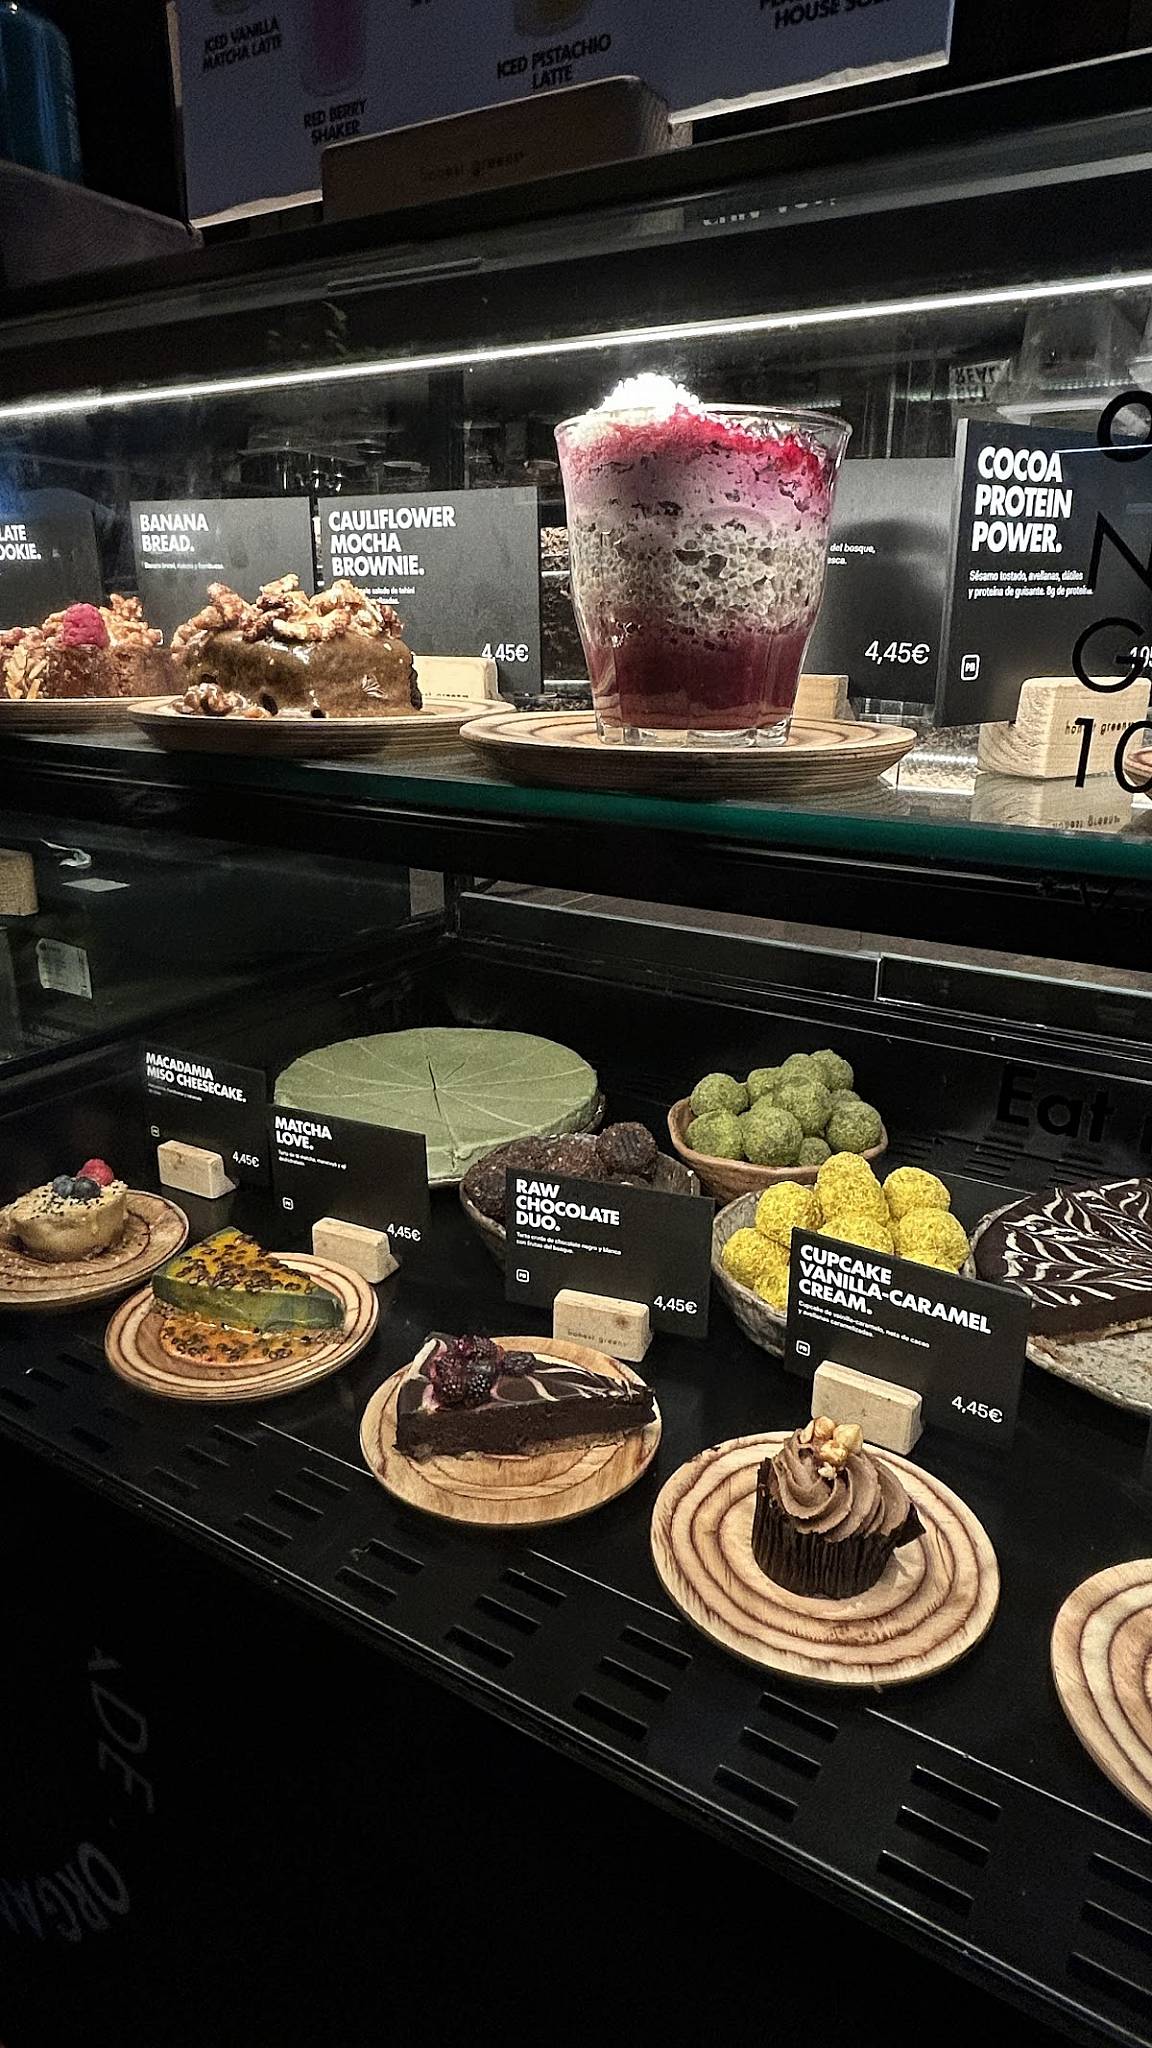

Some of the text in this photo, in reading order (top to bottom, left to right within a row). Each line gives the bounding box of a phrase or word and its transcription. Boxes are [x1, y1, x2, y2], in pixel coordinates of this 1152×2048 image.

[204, 16, 280, 54] ICED VANILLA
[202, 34, 283, 73] MATCHA LATTE
[497, 34, 611, 79] ICED PISTACHIO
[531, 65, 574, 90] LATTE
[303, 98, 368, 129] RED BERRY
[311, 119, 360, 145] SHAKER
[977, 446, 1063, 483] COCOA
[975, 484, 1073, 519] PROTEIN
[140, 513, 209, 532] BANANA
[328, 505, 456, 532] CAULIFLOWER
[142, 535, 195, 552] BREAD.
[330, 532, 402, 554] MOCHA
[830, 543, 876, 555] del bosque,
[971, 522, 1063, 554] POWER.
[332, 555, 425, 577] BROWNIE.
[969, 569, 998, 582] Sésamo
[1004, 586, 1014, 596] de
[1056, 586, 1064, 595] de
[864, 640, 930, 665] 4,45€
[146, 1052, 214, 1081] MACADAMIA
[147, 1065, 174, 1083] MISO
[176, 1074, 247, 1103] CHEESECAKE.
[275, 1116, 332, 1140] MATCHA
[276, 1130, 314, 1150] LOVE.
[516, 1179, 560, 1198] RAW
[516, 1196, 620, 1226] CHOCOLATE
[516, 1211, 561, 1232] DUO.
[387, 1223, 421, 1241] 4,45€
[800, 1245, 893, 1286] CUPCAKE
[653, 1295, 698, 1314] 4,45€
[799, 1279, 873, 1315] CREAM.
[799, 1260, 992, 1335] VANILLA-CARAMEL
[952, 1395, 1003, 1424] 4,45€
